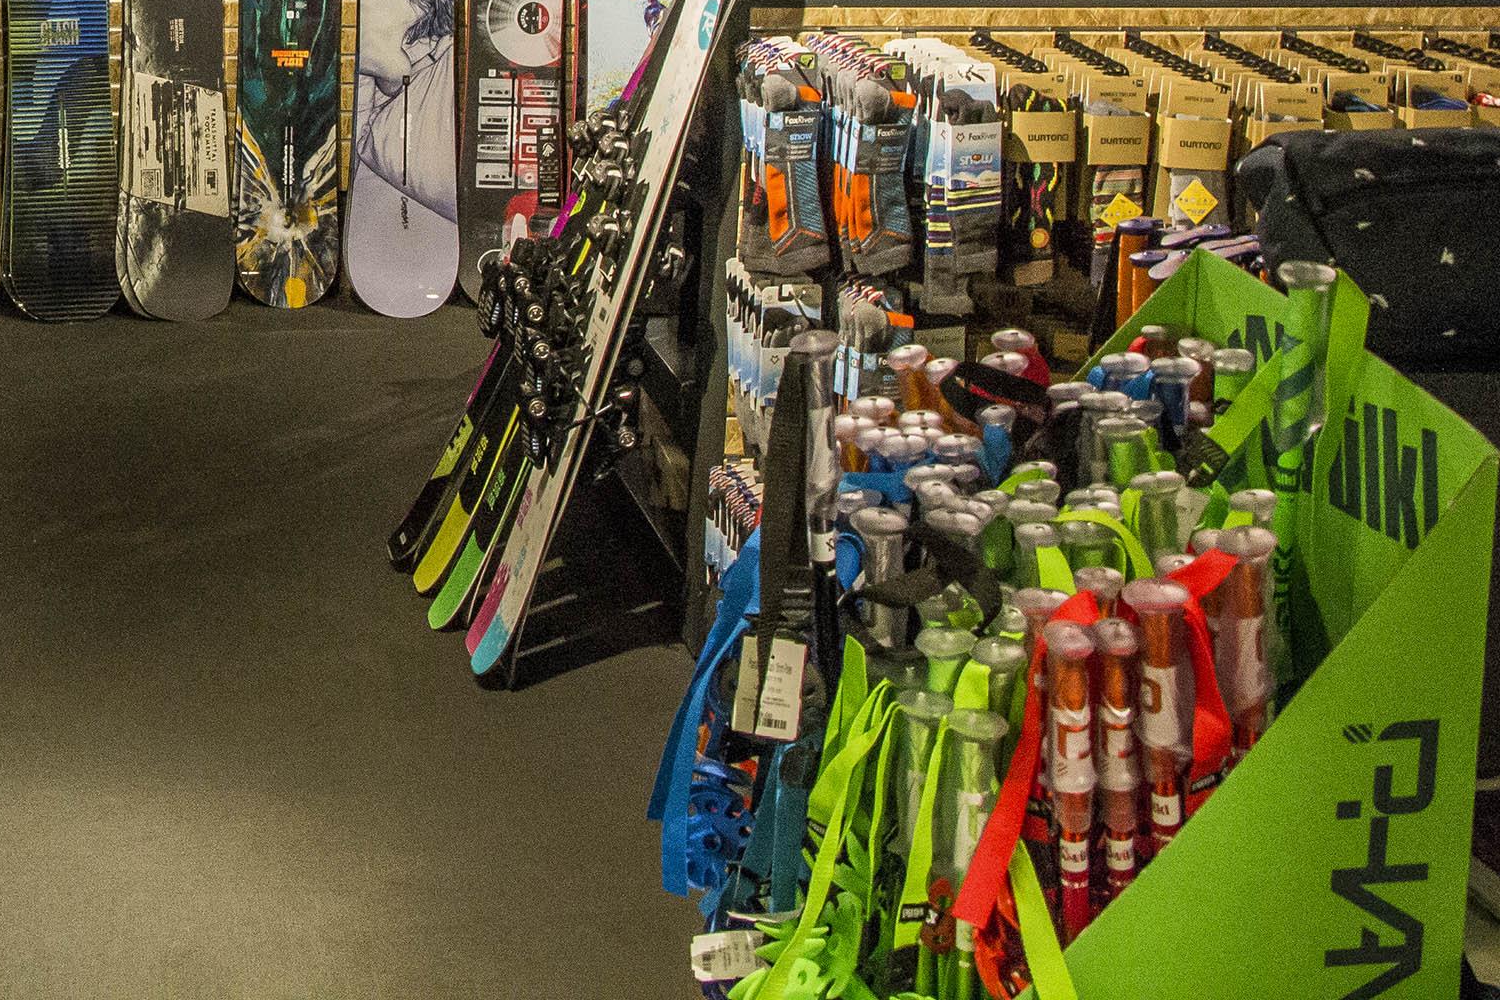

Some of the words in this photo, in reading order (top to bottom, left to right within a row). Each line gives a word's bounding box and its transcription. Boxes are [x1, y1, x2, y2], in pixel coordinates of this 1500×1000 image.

[1028, 134, 1062, 142] BURTON
[1100, 137, 1135, 145] BURTON
[1179, 140, 1214, 149] BURTON
